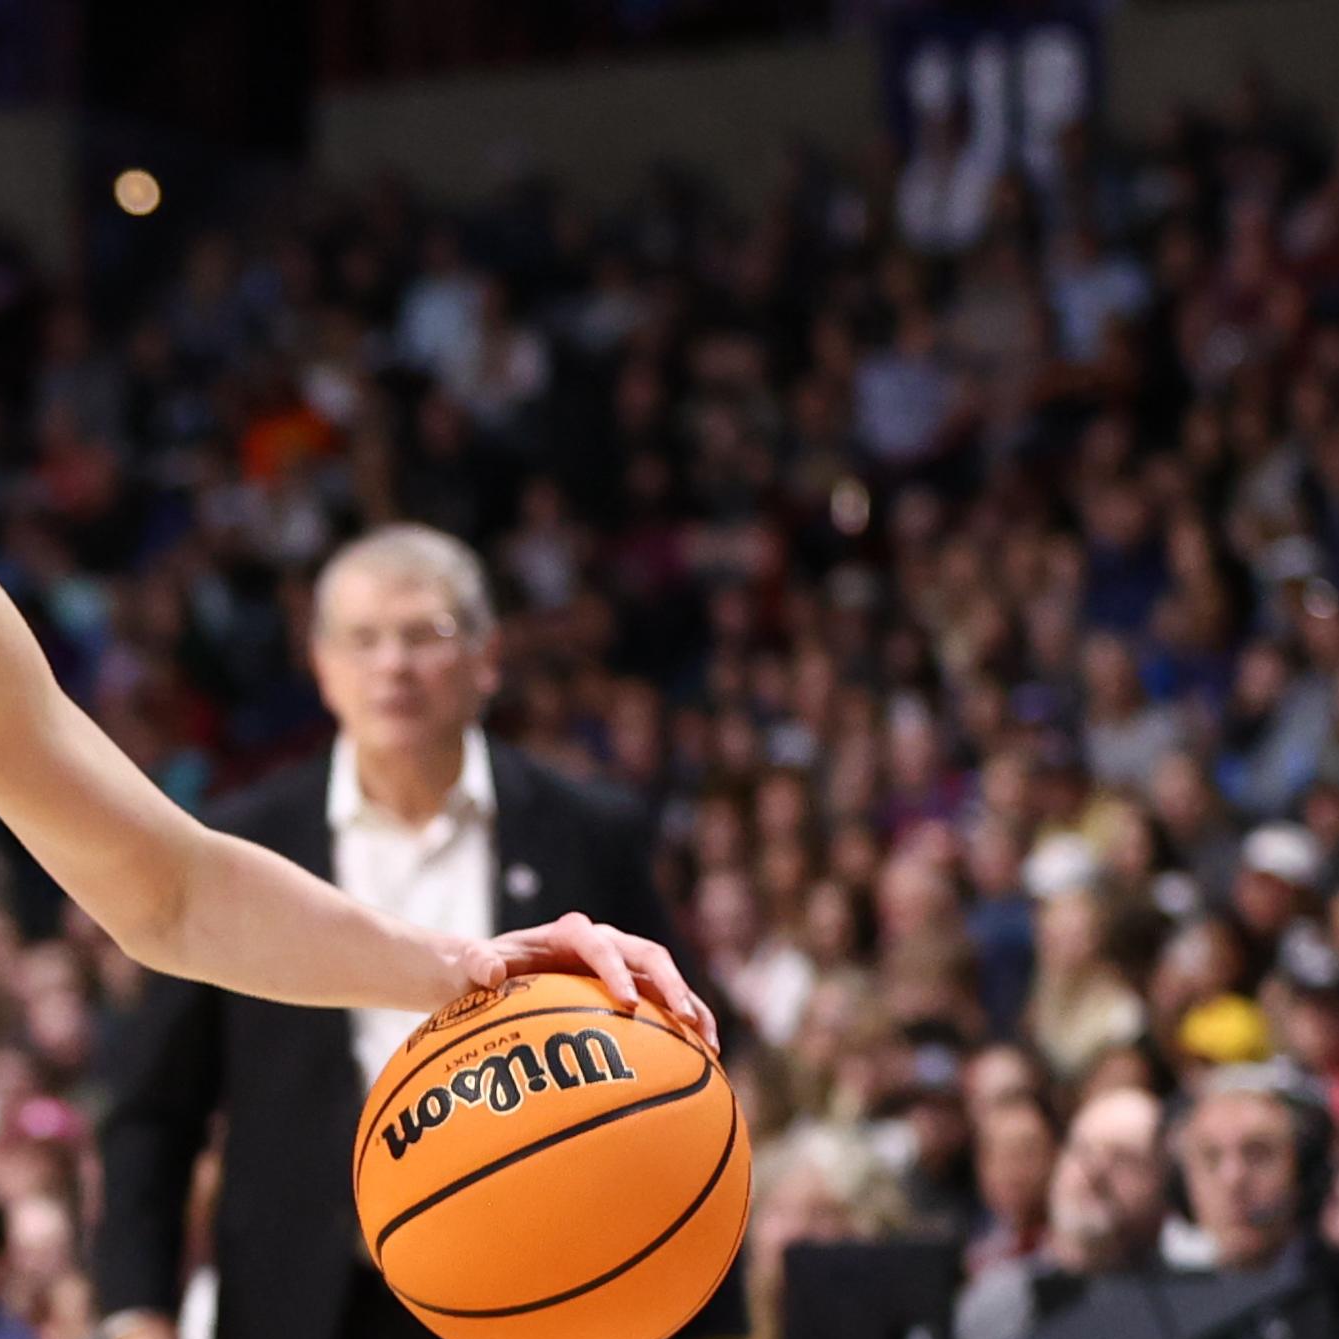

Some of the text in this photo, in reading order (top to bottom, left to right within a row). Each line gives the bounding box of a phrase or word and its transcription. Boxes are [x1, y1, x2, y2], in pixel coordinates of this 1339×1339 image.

[380, 1026, 639, 1161] Wilson
[443, 1031, 522, 1074] EVO NXT
